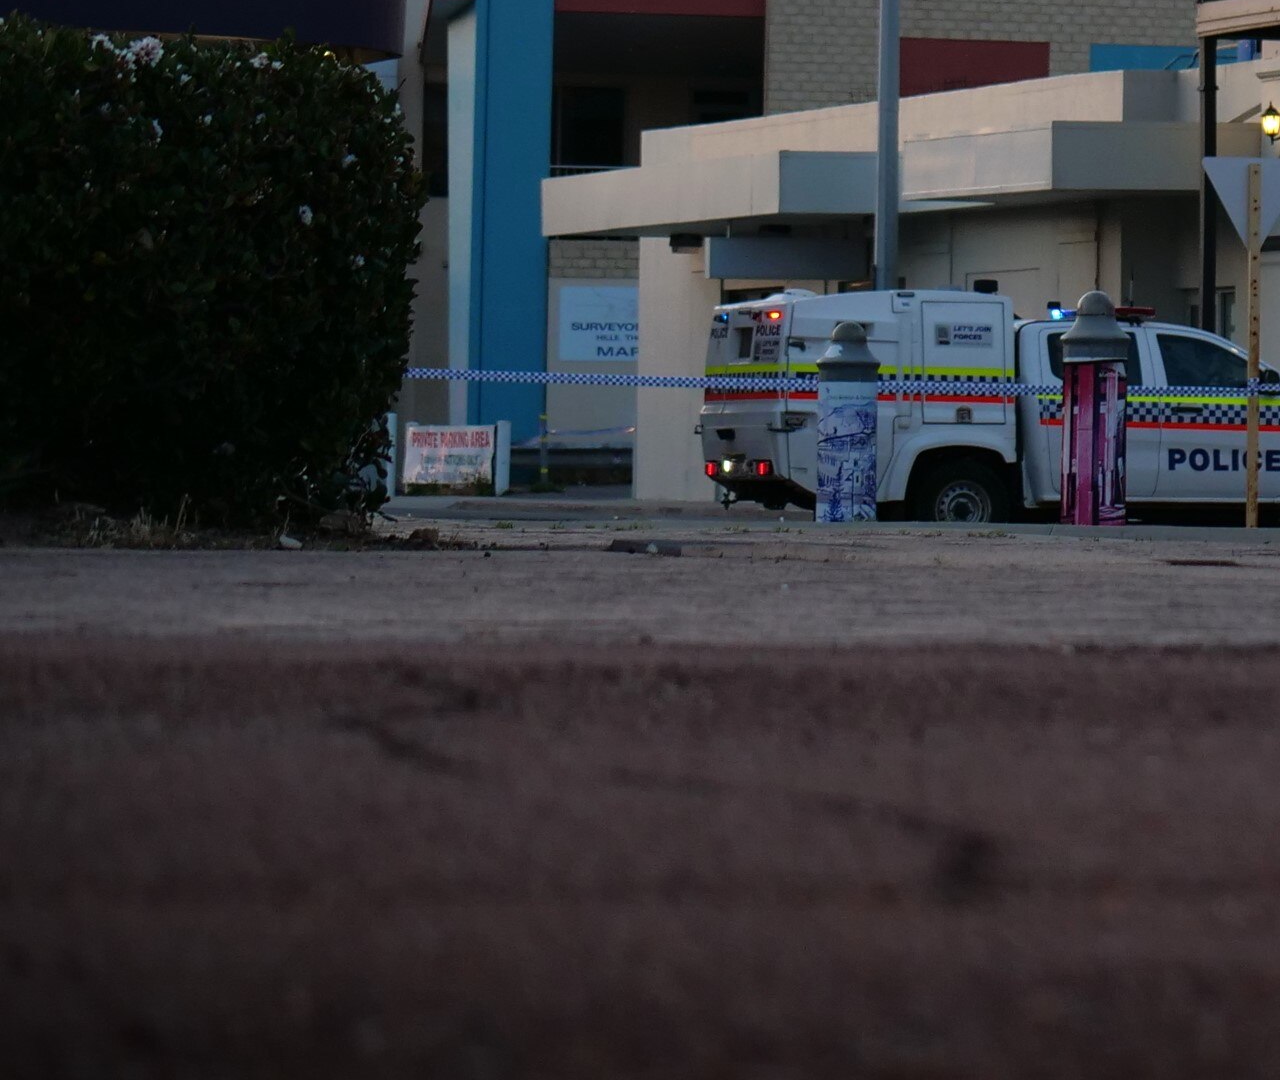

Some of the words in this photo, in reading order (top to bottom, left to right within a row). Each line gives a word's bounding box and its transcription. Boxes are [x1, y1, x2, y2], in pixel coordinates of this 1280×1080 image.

[710, 327, 728, 339] POLICE
[755, 324, 781, 337] POLICE
[953, 333, 983, 341] FORCES
[412, 431, 438, 449] PRIVATE
[440, 431, 470, 448] PARKING
[470, 430, 491, 448] AREA
